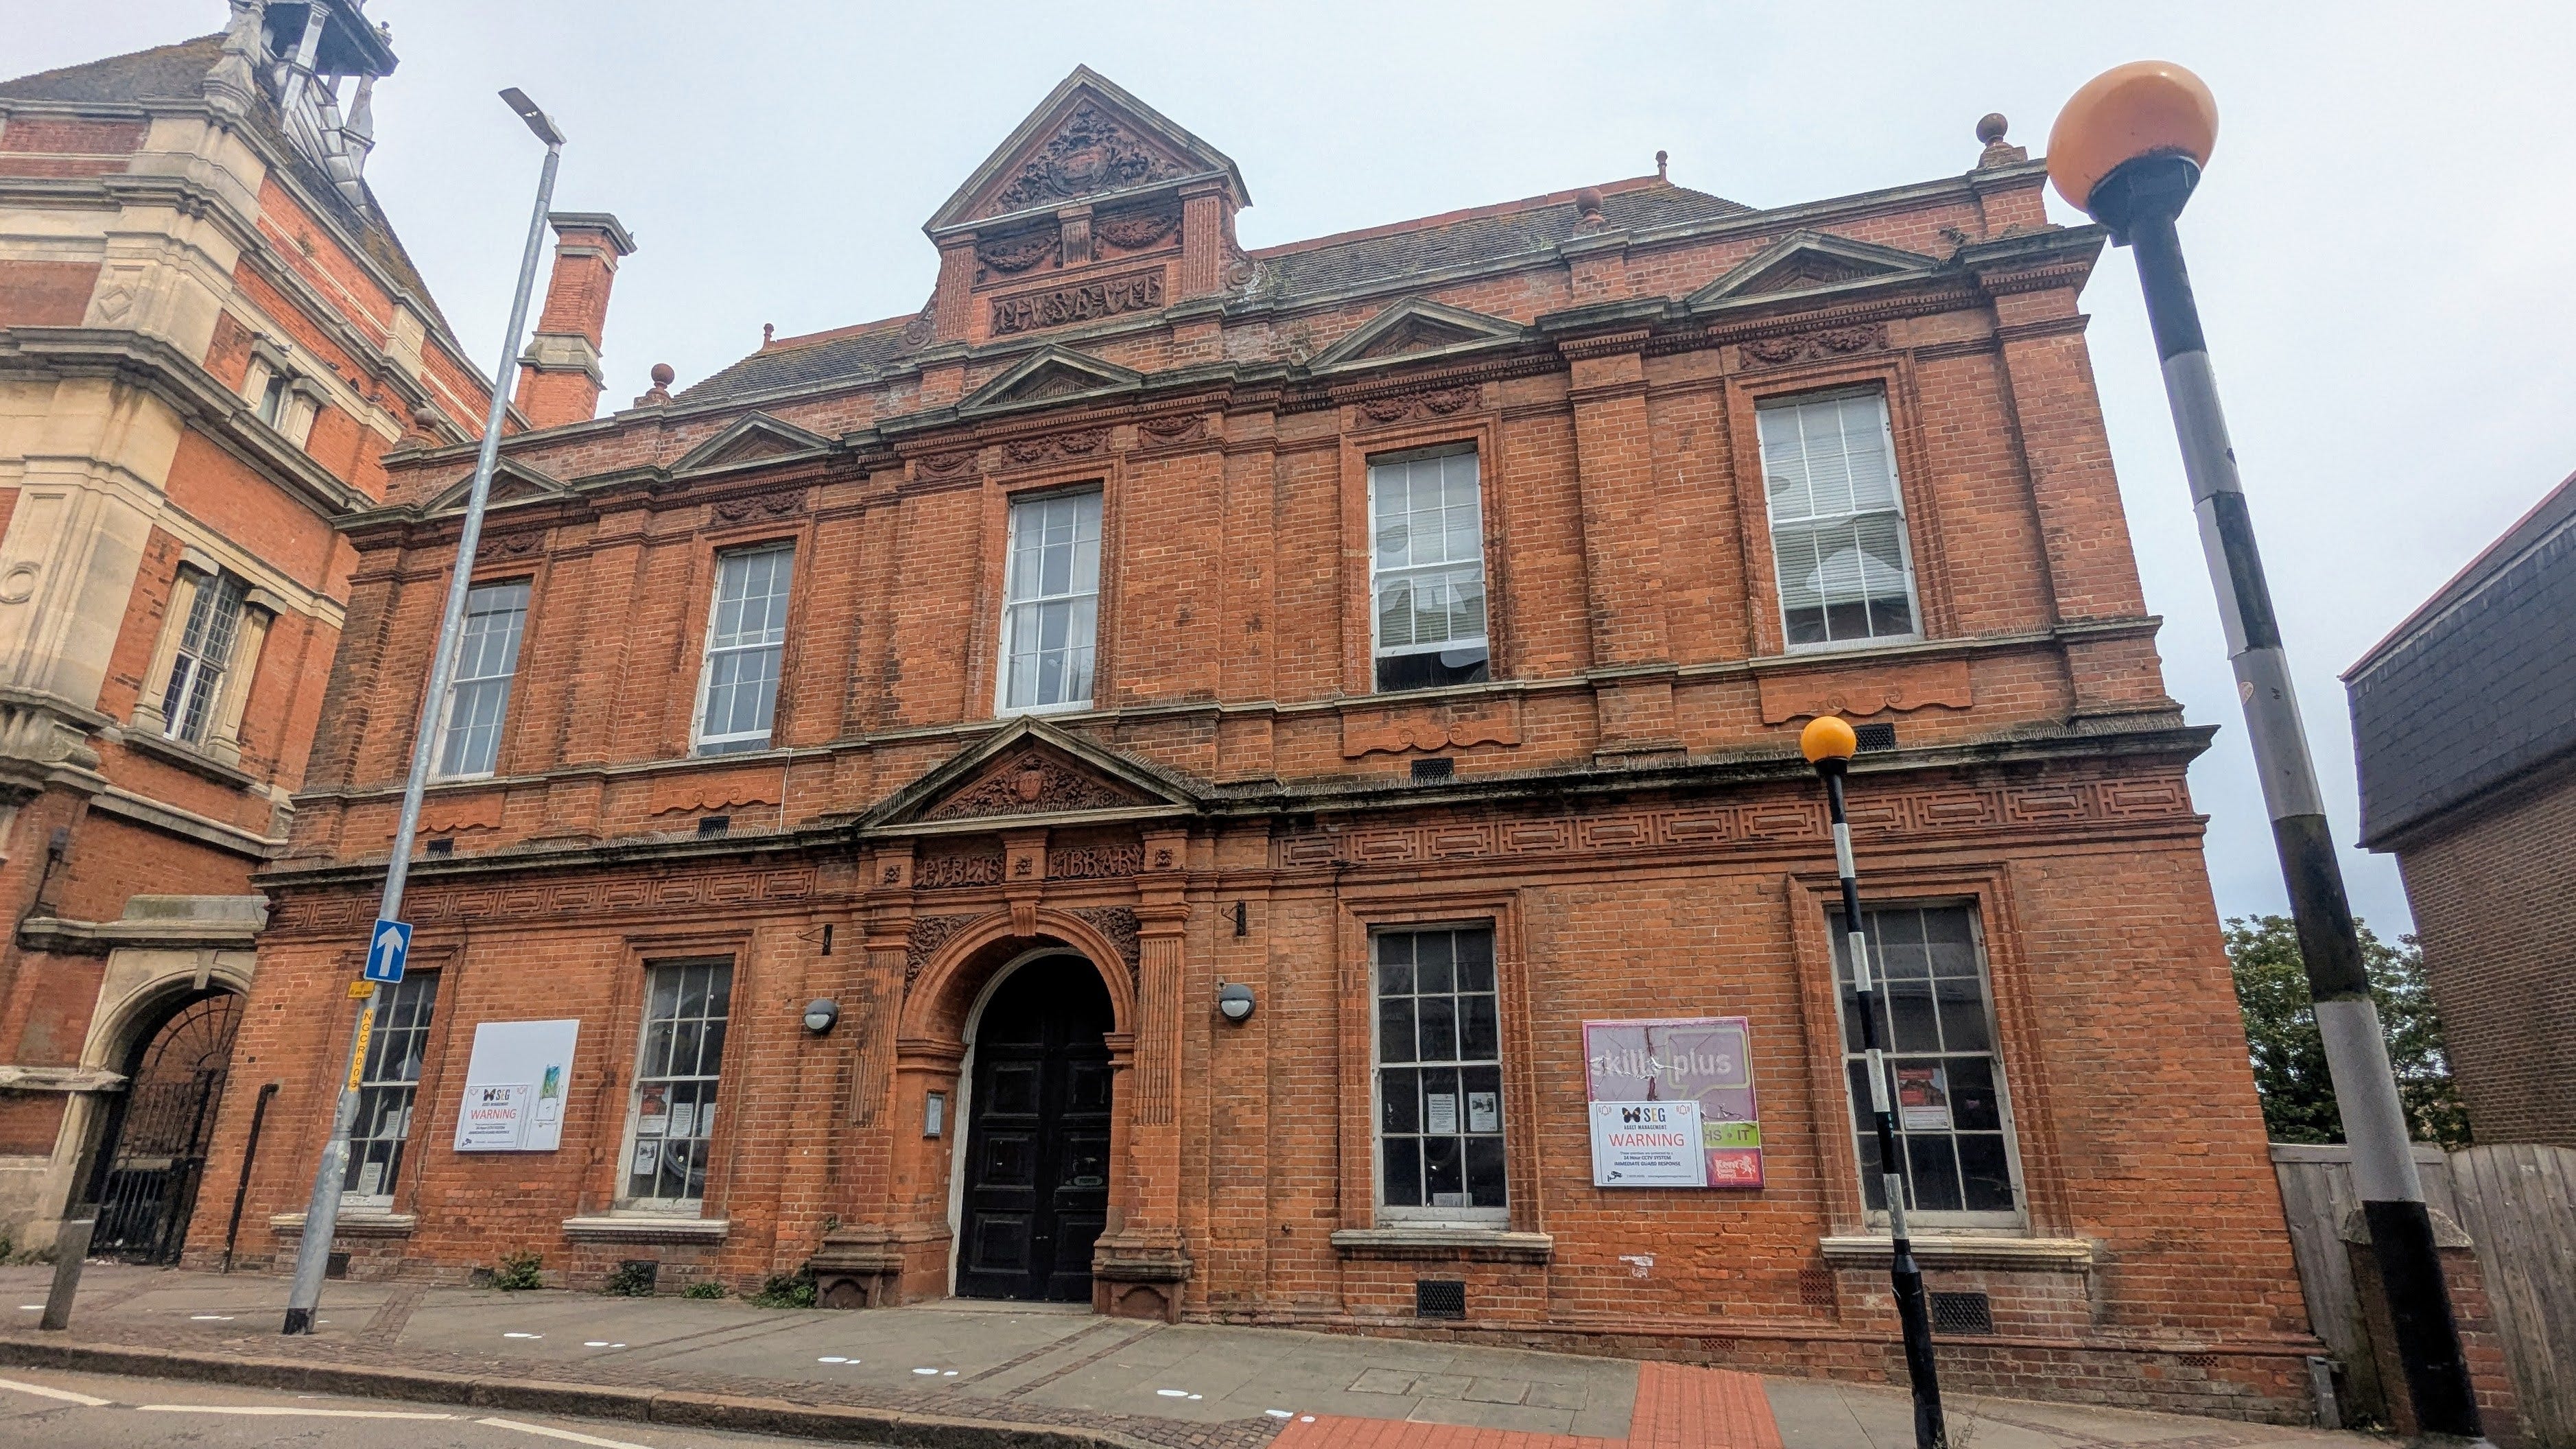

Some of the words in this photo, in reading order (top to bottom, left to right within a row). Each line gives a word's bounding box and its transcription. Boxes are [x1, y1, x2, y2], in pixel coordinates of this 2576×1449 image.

[1048, 845, 1145, 877] LIBRARY
[1674, 1048, 1732, 1083] plus
[496, 1089, 510, 1100] SEG
[471, 1109, 517, 1120] WARNING
[1643, 1107, 1666, 1122] SEG
[1608, 1133, 1684, 1147] WARNING
[1737, 1129, 1749, 1140] IT
